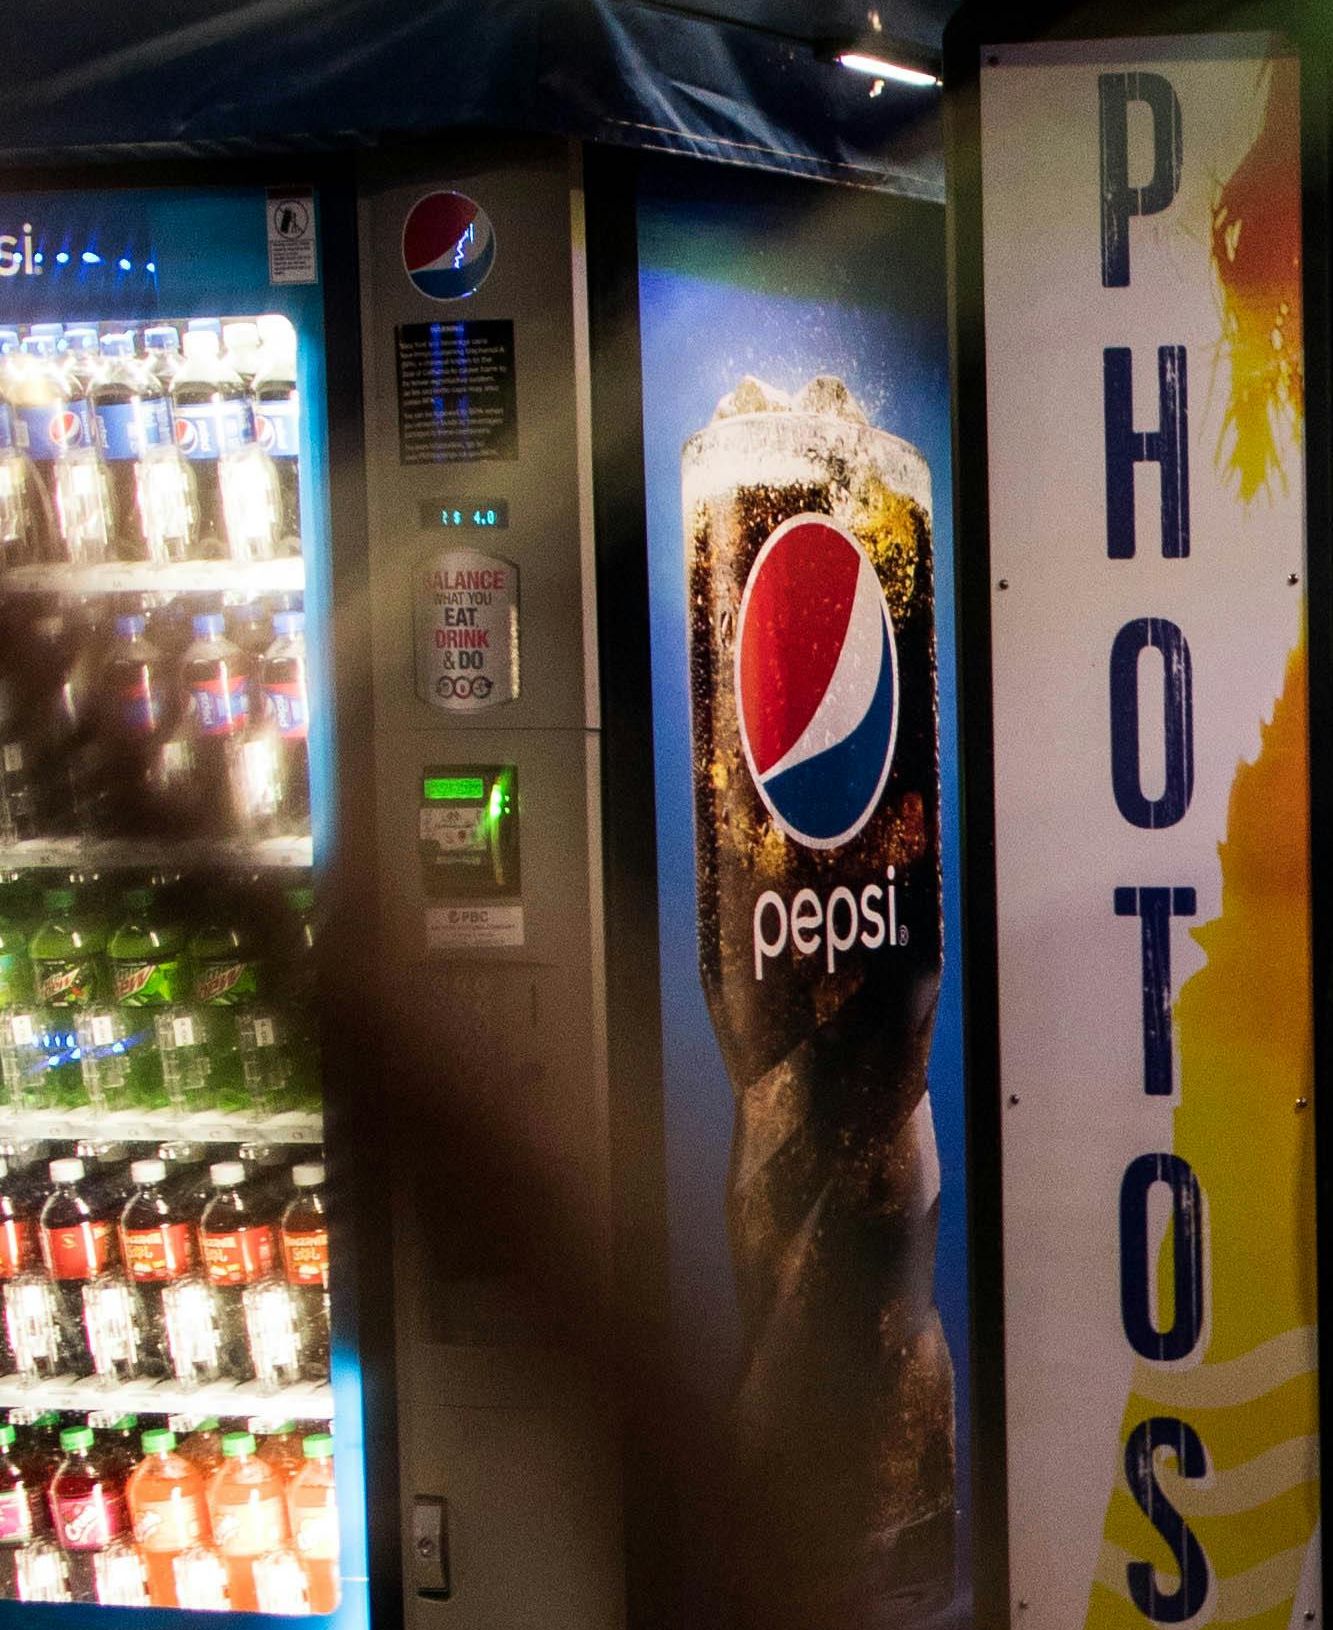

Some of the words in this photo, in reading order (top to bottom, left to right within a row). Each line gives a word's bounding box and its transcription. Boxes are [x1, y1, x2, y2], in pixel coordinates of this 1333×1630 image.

[468, 591, 492, 606] YOU
[434, 629, 490, 649] DRINK
[443, 650, 456, 671] &
[458, 650, 484, 670] DO
[1098, 72, 1209, 1623] PHOTOS
